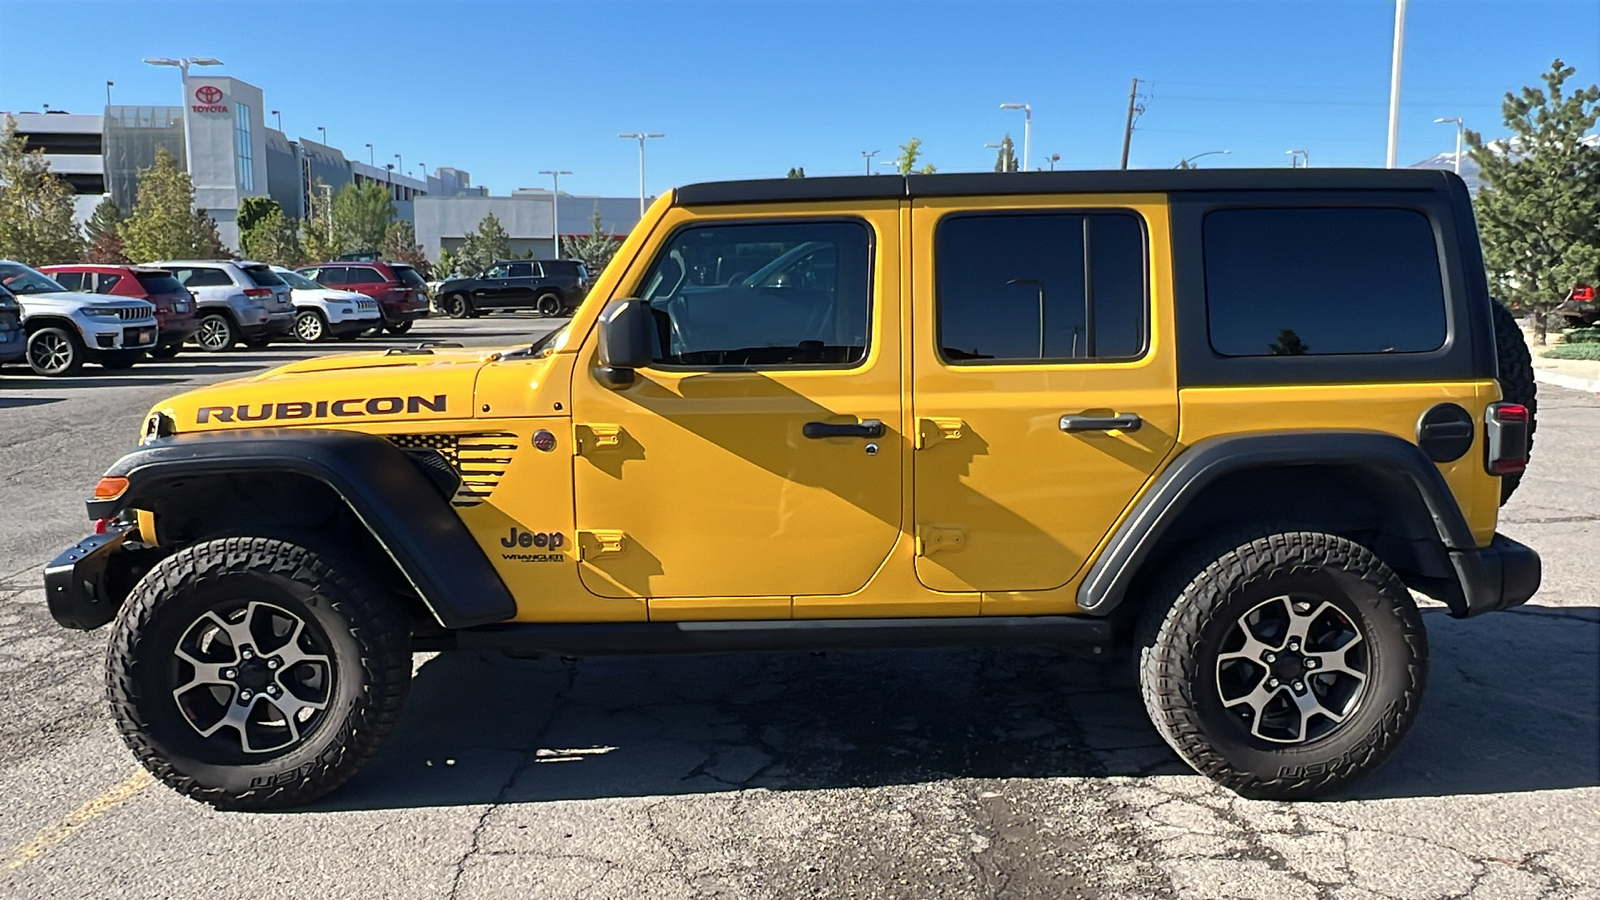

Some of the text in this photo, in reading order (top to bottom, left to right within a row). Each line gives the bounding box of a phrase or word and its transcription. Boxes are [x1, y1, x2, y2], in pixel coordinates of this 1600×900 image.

[191, 105, 229, 113] TOYOTA
[196, 394, 447, 424] RUBICON
[501, 527, 564, 551] Jeep
